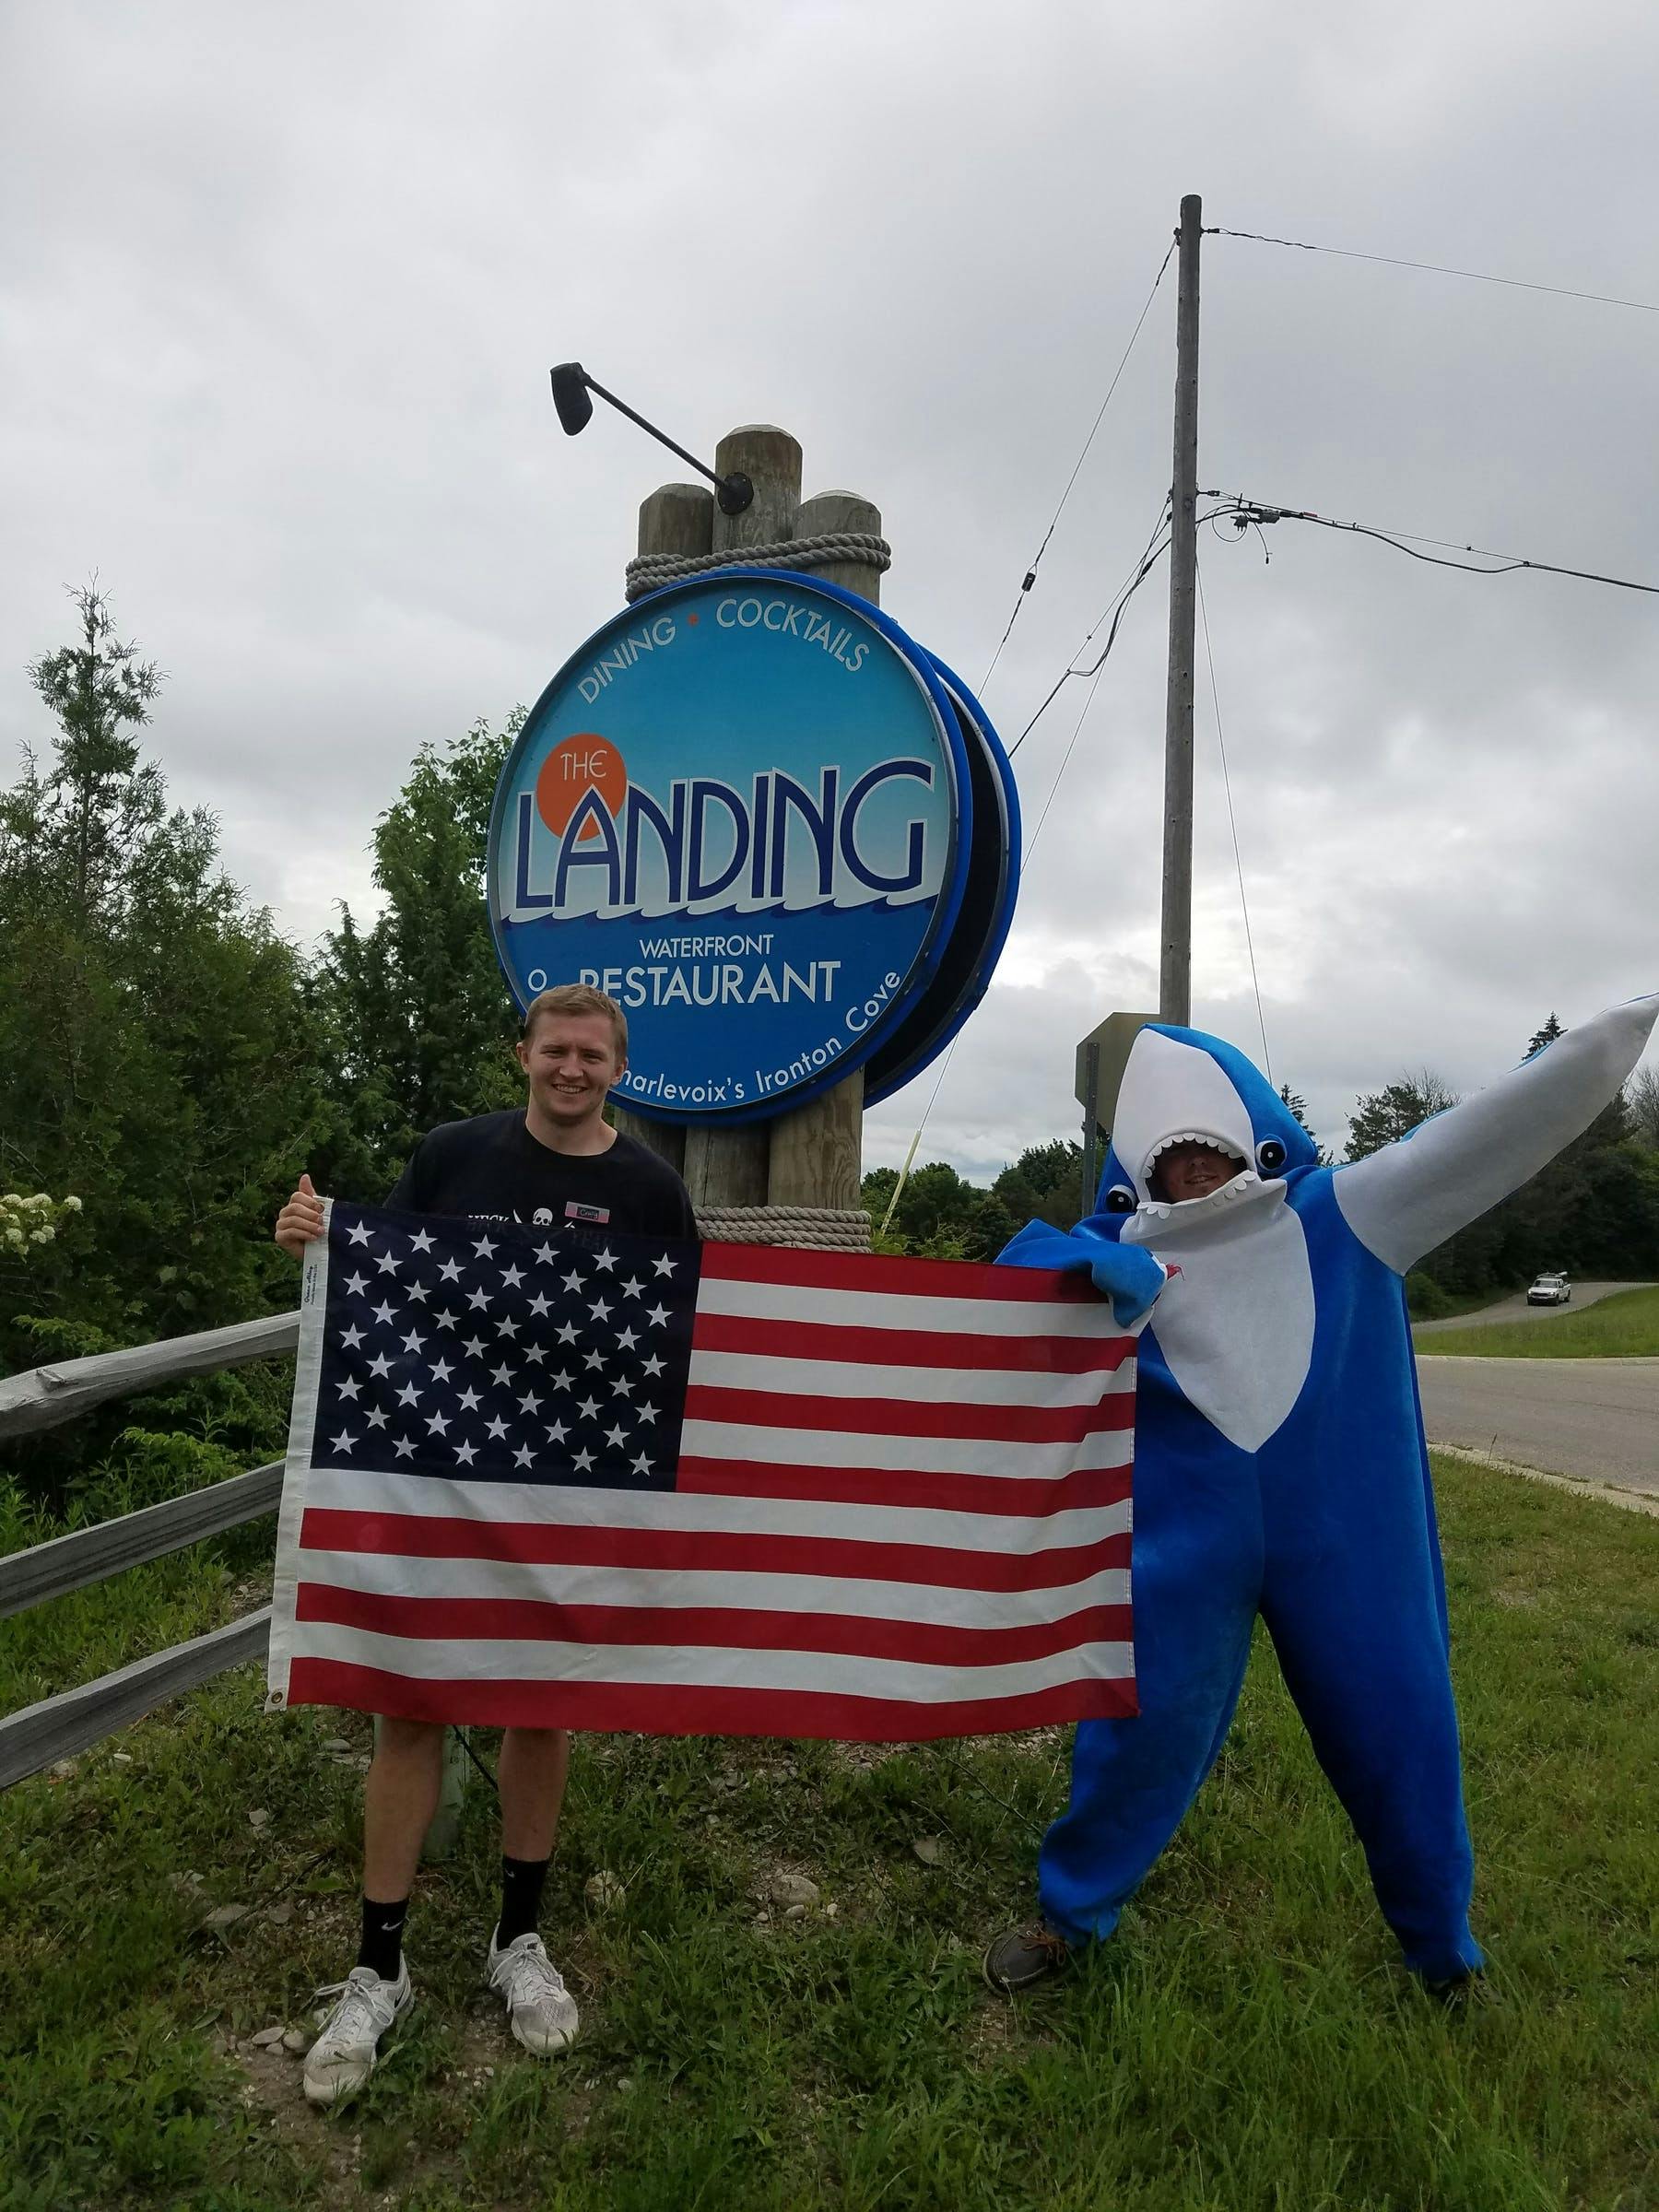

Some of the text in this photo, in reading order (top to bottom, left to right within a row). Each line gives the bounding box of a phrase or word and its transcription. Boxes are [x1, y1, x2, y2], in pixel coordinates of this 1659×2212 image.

[577, 598, 869, 704] DINING COCKTAILS
[559, 749, 607, 781] THE
[515, 756, 935, 911] LANDING
[639, 934, 774, 959] WATERFRONT
[619, 1069, 745, 1102] harlevoix's
[756, 1037, 842, 1093] Ironton
[845, 971, 900, 1032] Cove
